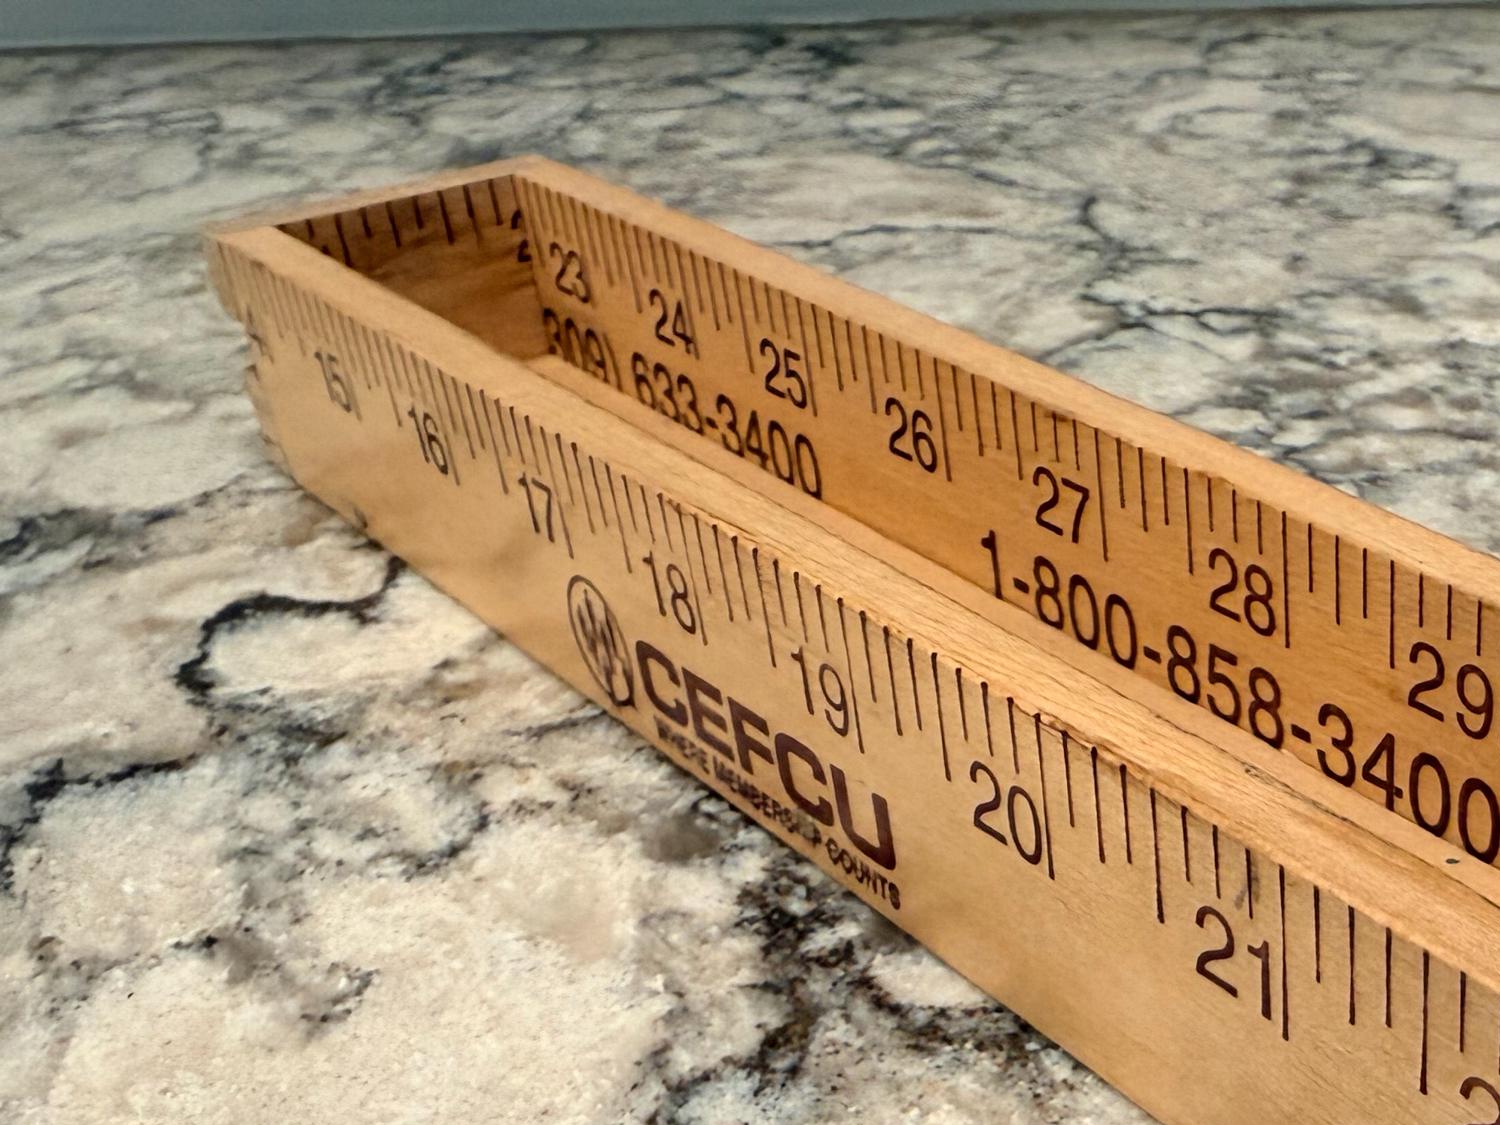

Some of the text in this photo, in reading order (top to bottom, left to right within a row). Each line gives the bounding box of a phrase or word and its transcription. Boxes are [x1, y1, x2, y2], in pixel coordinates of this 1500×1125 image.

[549, 241, 592, 303] 23
[649, 288, 695, 355] 24
[314, 350, 352, 414] 15
[759, 337, 808, 410] 25
[407, 404, 449, 476] 16
[631, 351, 822, 500] 633-3400
[884, 397, 938, 473] 26
[517, 471, 556, 544] 17
[1031, 465, 1090, 544] 27
[642, 549, 697, 635] 18
[1207, 547, 1278, 638] 28
[790, 643, 851, 738] 19
[980, 529, 1500, 865] 1-800-858-3400
[1407, 641, 1495, 740] 29
[635, 639, 898, 871] CEFCU
[969, 759, 1043, 867] 20
[1195, 905, 1273, 1021] 21
